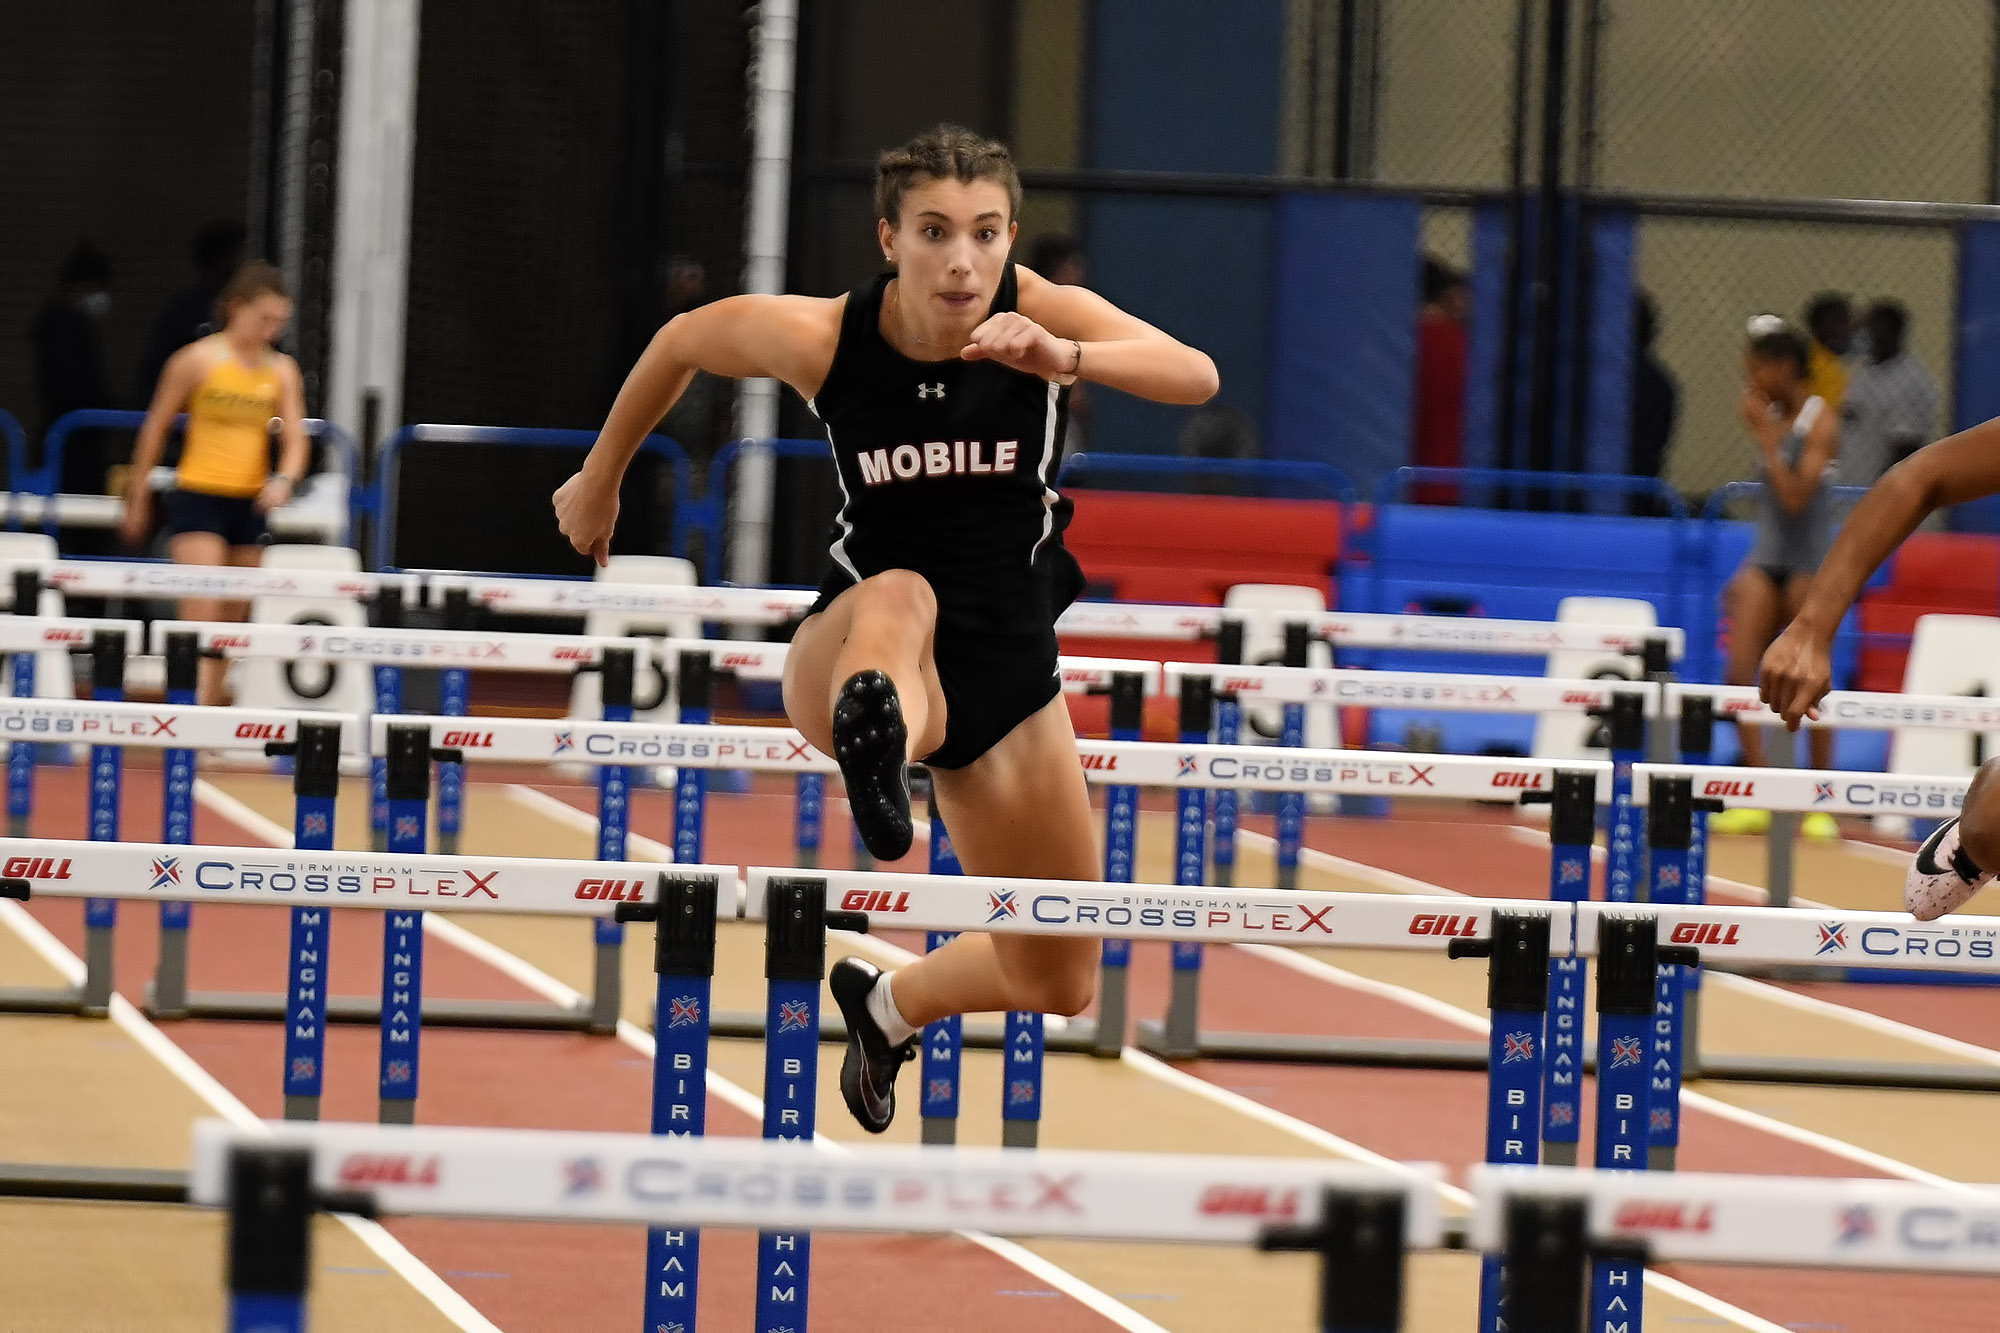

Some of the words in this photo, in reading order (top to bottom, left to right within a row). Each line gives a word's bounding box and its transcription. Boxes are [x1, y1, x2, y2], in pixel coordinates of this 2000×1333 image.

[857, 440, 1019, 484] MOBILE
[235, 722, 286, 741] GILL
[442, 731, 495, 749] GILL
[1490, 771, 1543, 789] GILL
[1703, 780, 1755, 797] GILL
[2, 857, 73, 880] GILL
[287, 862, 413, 876] BIRMINGHAM
[574, 878, 645, 901] GILL
[840, 889, 911, 912] GILL
[1123, 896, 1247, 909] BIRMINGHAM
[1408, 913, 1478, 937] GILL
[1670, 922, 1740, 945] GILL
[1951, 928, 1997, 938] BIRM
[294, 911, 321, 1040] MINGHAM
[389, 915, 414, 1043] MINGHAM
[1553, 958, 1577, 1086] MINGHAM
[1651, 963, 1676, 1091] MINGHAM
